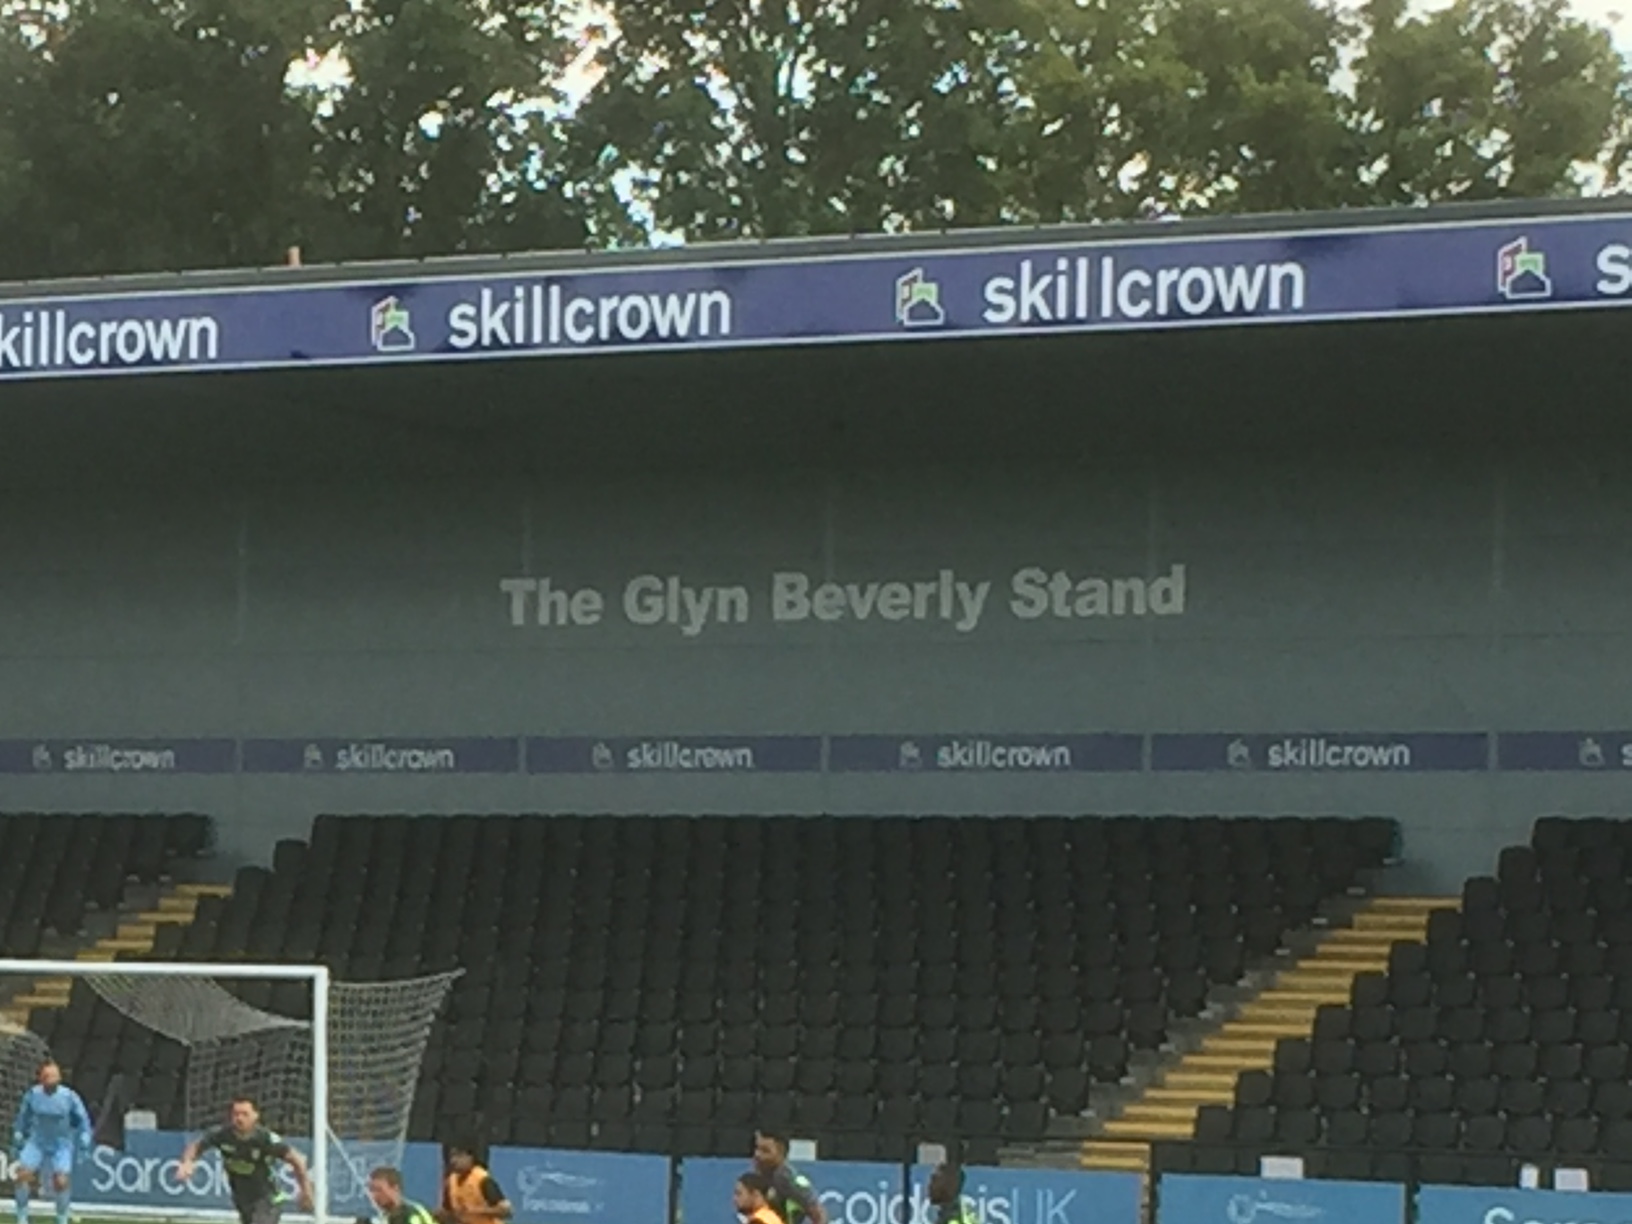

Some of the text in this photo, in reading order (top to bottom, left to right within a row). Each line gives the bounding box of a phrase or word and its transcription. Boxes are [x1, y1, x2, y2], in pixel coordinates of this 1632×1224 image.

[983, 257, 1306, 325] skillcrown
[447, 286, 734, 350] skillcrown
[499, 564, 1187, 636] The Glyn Beverly Stand
[64, 746, 175, 770] skillcrown
[336, 744, 455, 769] skillcrown
[627, 743, 753, 768] skillcrown
[937, 740, 1071, 767] skillcrown
[1268, 738, 1411, 767] skillcrown
